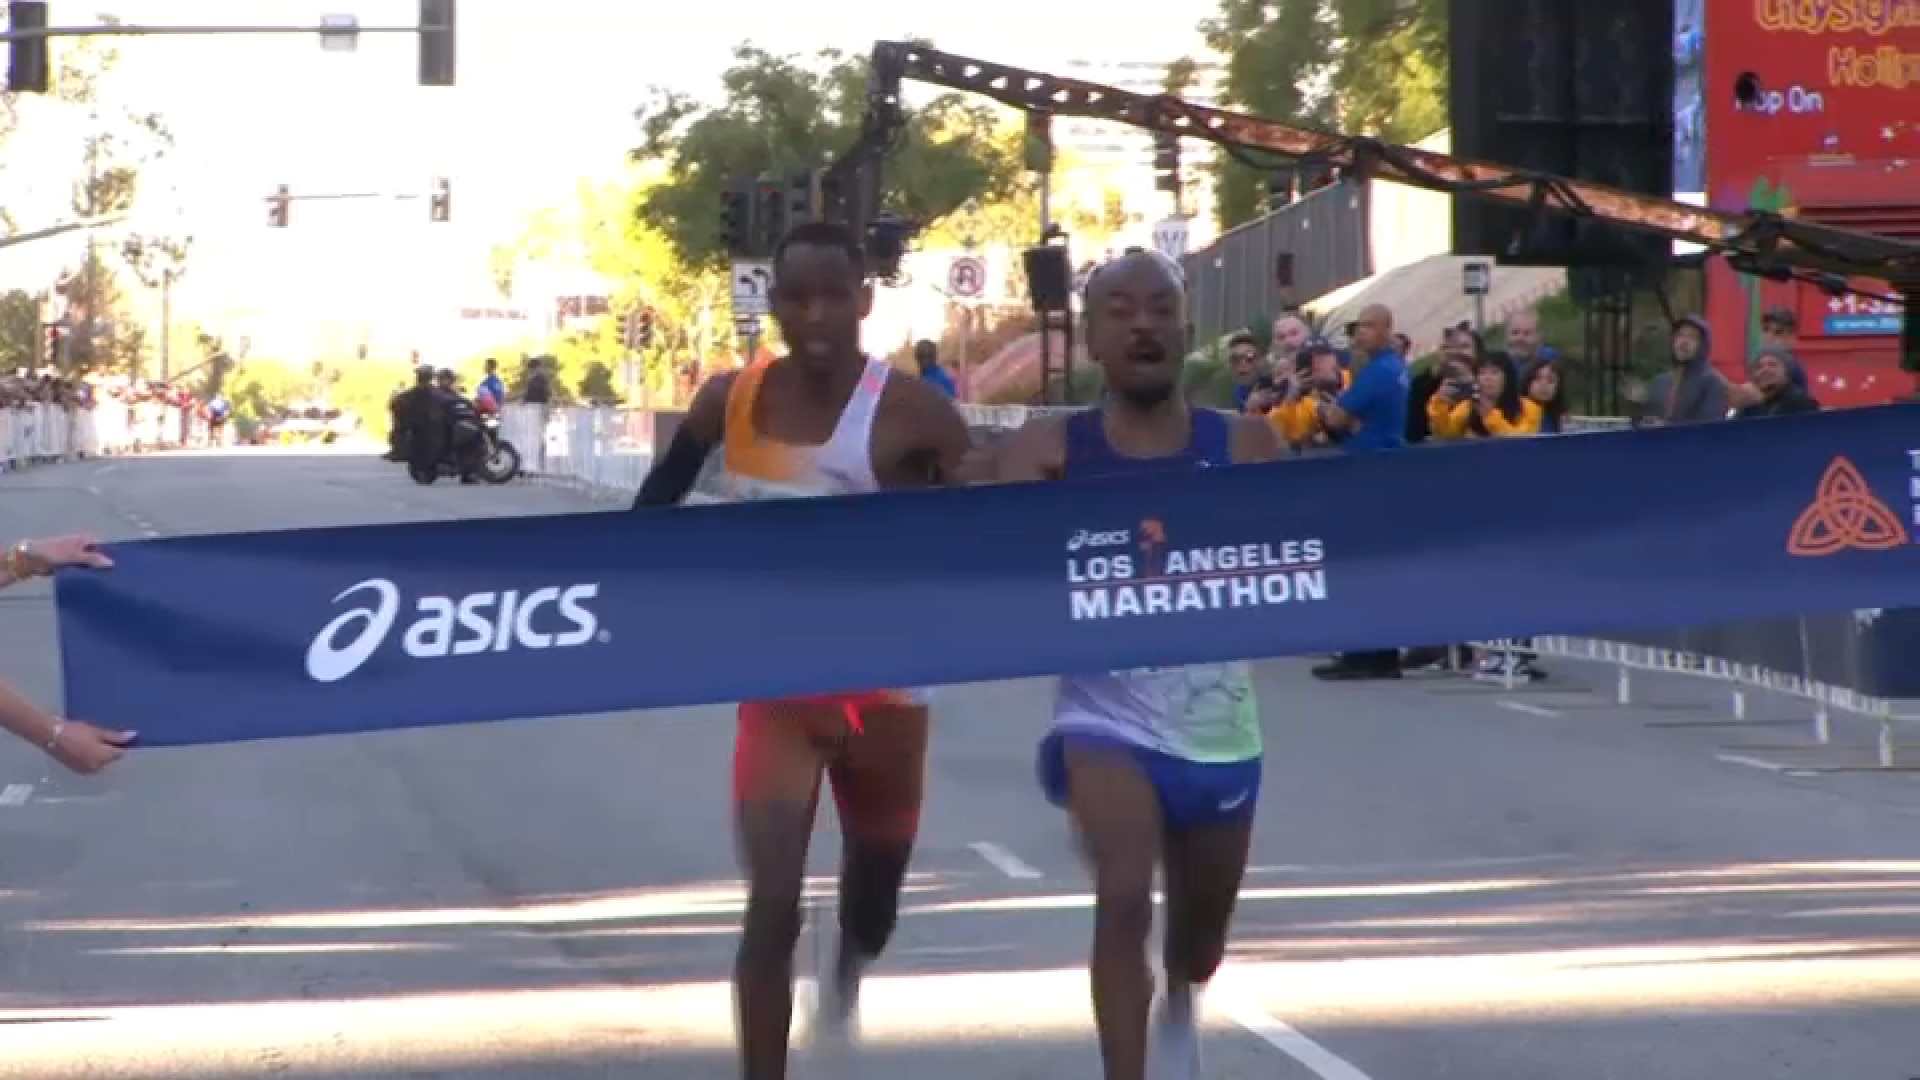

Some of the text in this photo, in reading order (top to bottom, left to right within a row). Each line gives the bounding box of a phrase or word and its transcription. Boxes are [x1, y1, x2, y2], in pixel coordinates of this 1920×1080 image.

[1788, 85, 1824, 112] On
[1066, 538, 1324, 582] LOS ANGELES
[1069, 569, 1326, 620] MARATHON
